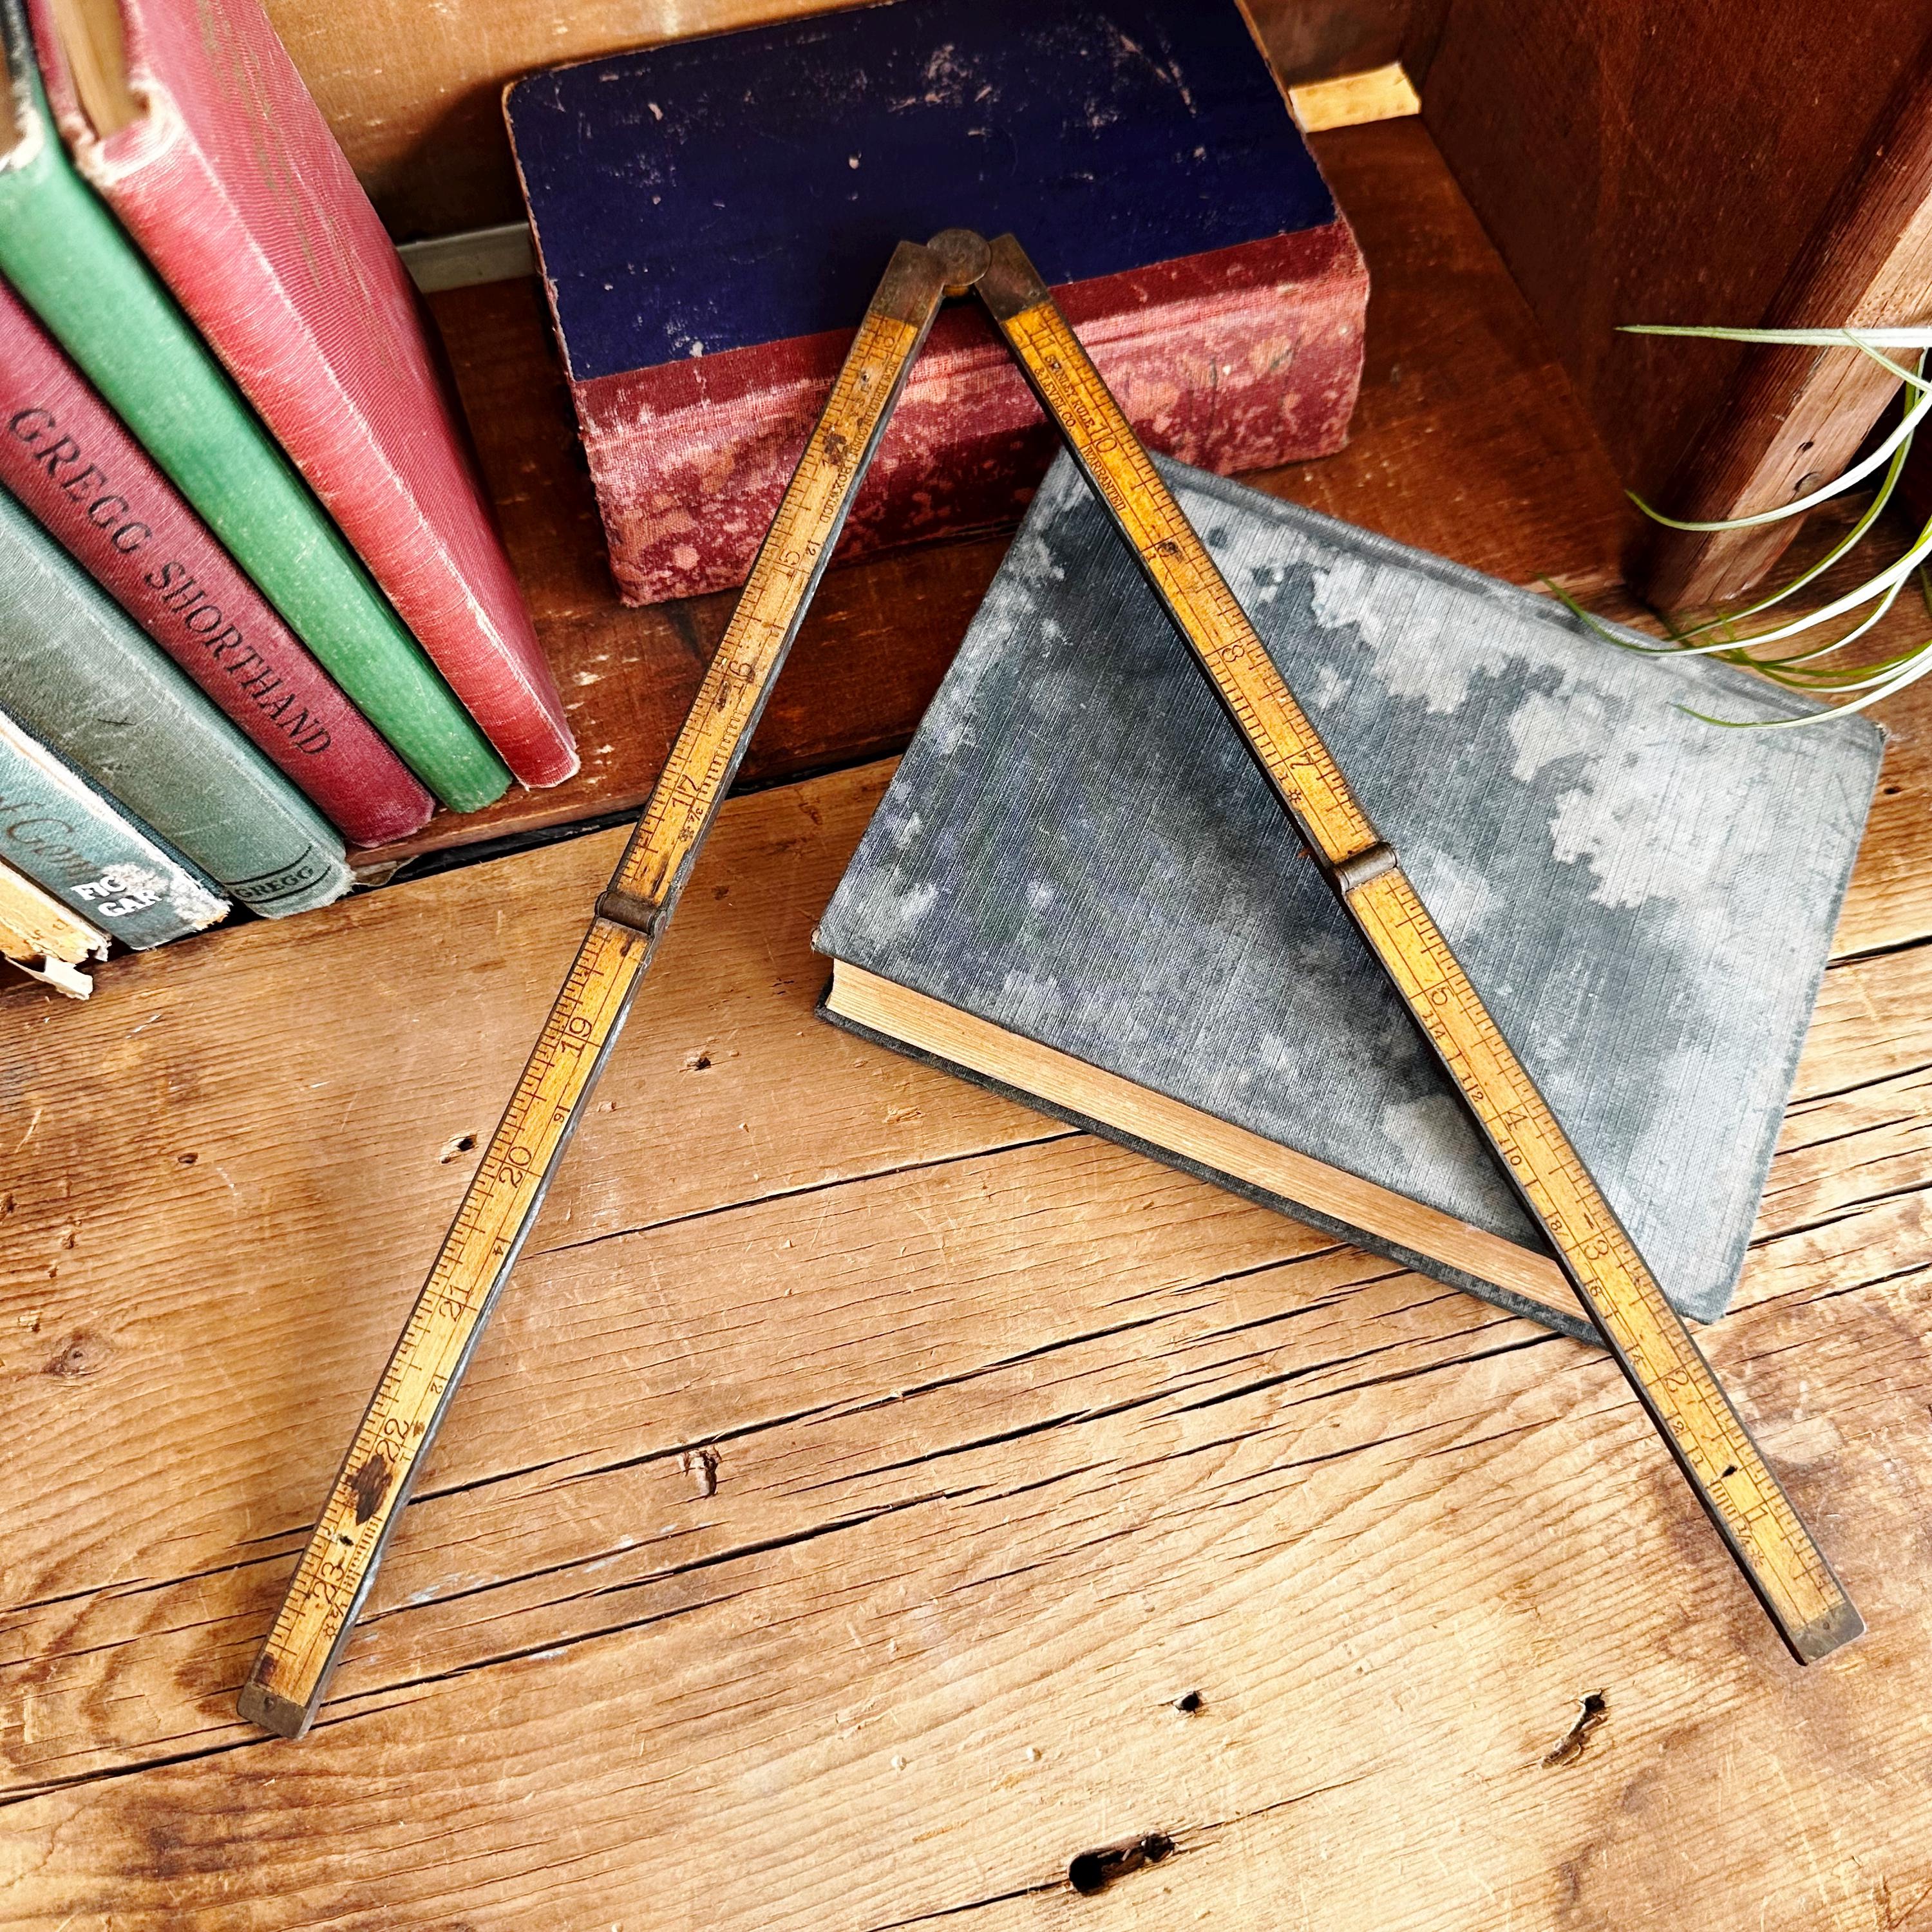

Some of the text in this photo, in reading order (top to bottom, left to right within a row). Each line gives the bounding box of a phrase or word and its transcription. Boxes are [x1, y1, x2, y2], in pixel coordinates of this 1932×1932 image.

[883, 360, 897, 382] NEW
[1034, 367, 1076, 431] & LEVEL CO.
[1045, 355, 1095, 428] SANLEY RULE
[1092, 425, 1117, 452] 10
[818, 464, 853, 524] BOXWOOD
[1083, 446, 1126, 511] WARRANTED
[775, 547, 800, 578] 15
[9, 408, 332, 755] GREGG SHORTHAND
[1222, 645, 1244, 663] 8
[1290, 751, 1312, 769] 7
[672, 775, 701, 809] 17
[70, 876, 126, 900] FIC
[235, 866, 314, 898] GREGG
[98, 890, 162, 916] GAR
[1432, 987, 1454, 1006] 5
[560, 1016, 592, 1058] 19
[1505, 1111, 1528, 1132] 4
[498, 1146, 533, 1189] 20
[1584, 1239, 1609, 1260] 3
[439, 1283, 473, 1321] 21
[431, 1383, 443, 1394] 2
[1665, 1371, 1689, 1393] 2
[375, 1418, 410, 1462] 22
[1745, 1507, 1768, 1522] 1
[314, 1562, 345, 1604] 23
